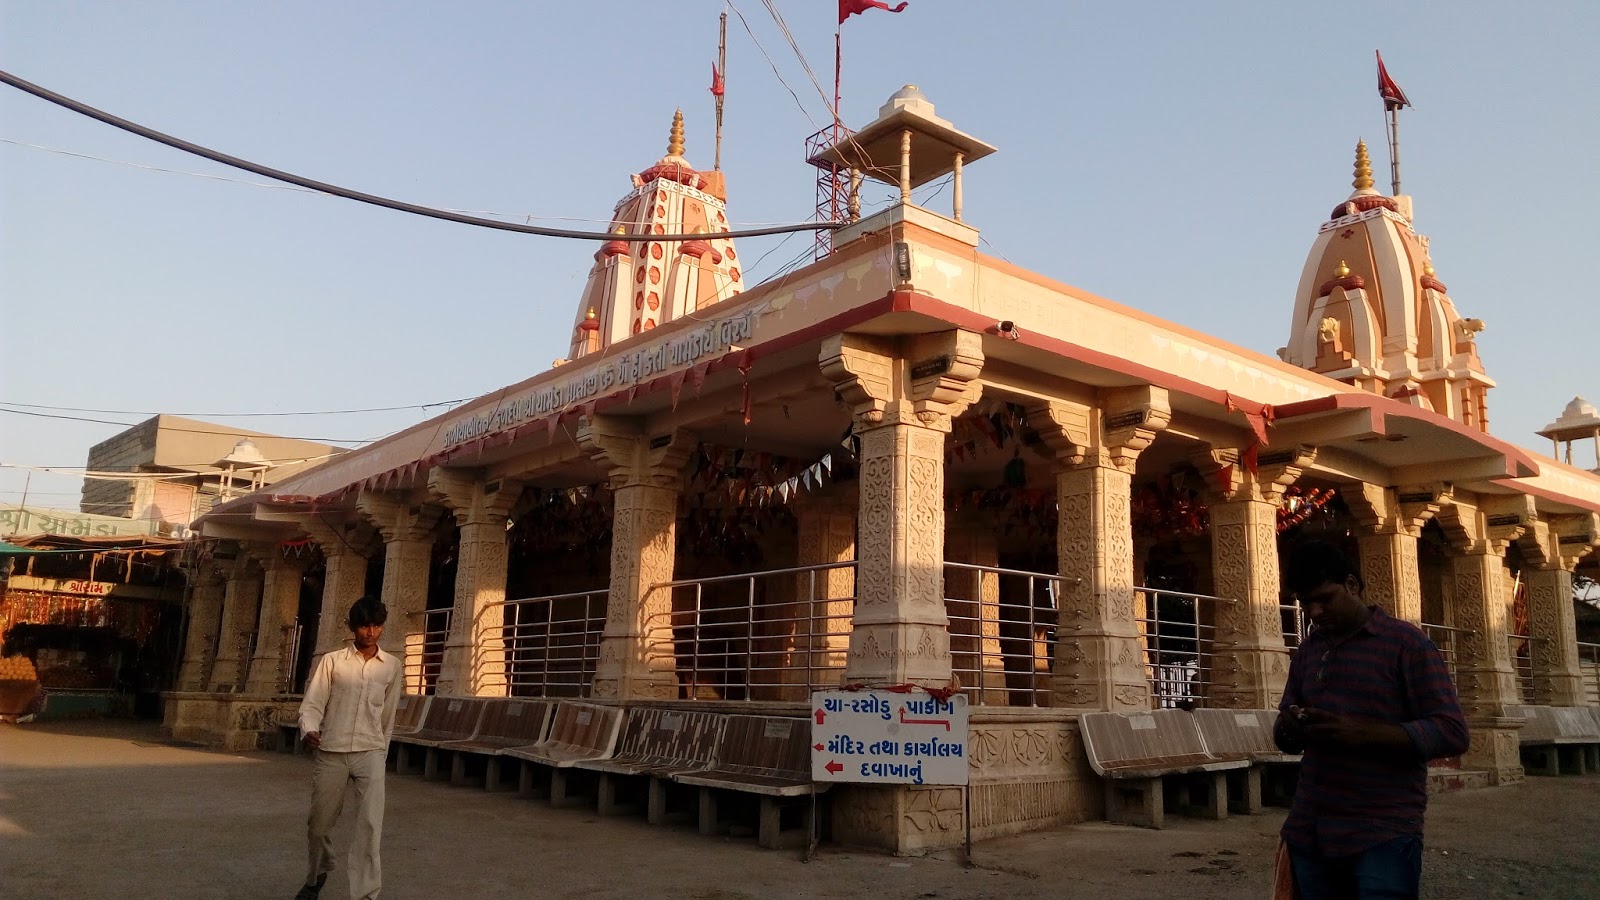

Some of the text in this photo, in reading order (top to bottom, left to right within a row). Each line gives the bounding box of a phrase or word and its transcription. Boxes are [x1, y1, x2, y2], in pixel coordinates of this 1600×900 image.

[828, 734, 963, 758] મંદિર તથા કાર્યાલય
[860, 759, 924, 785] દવાખાનું
